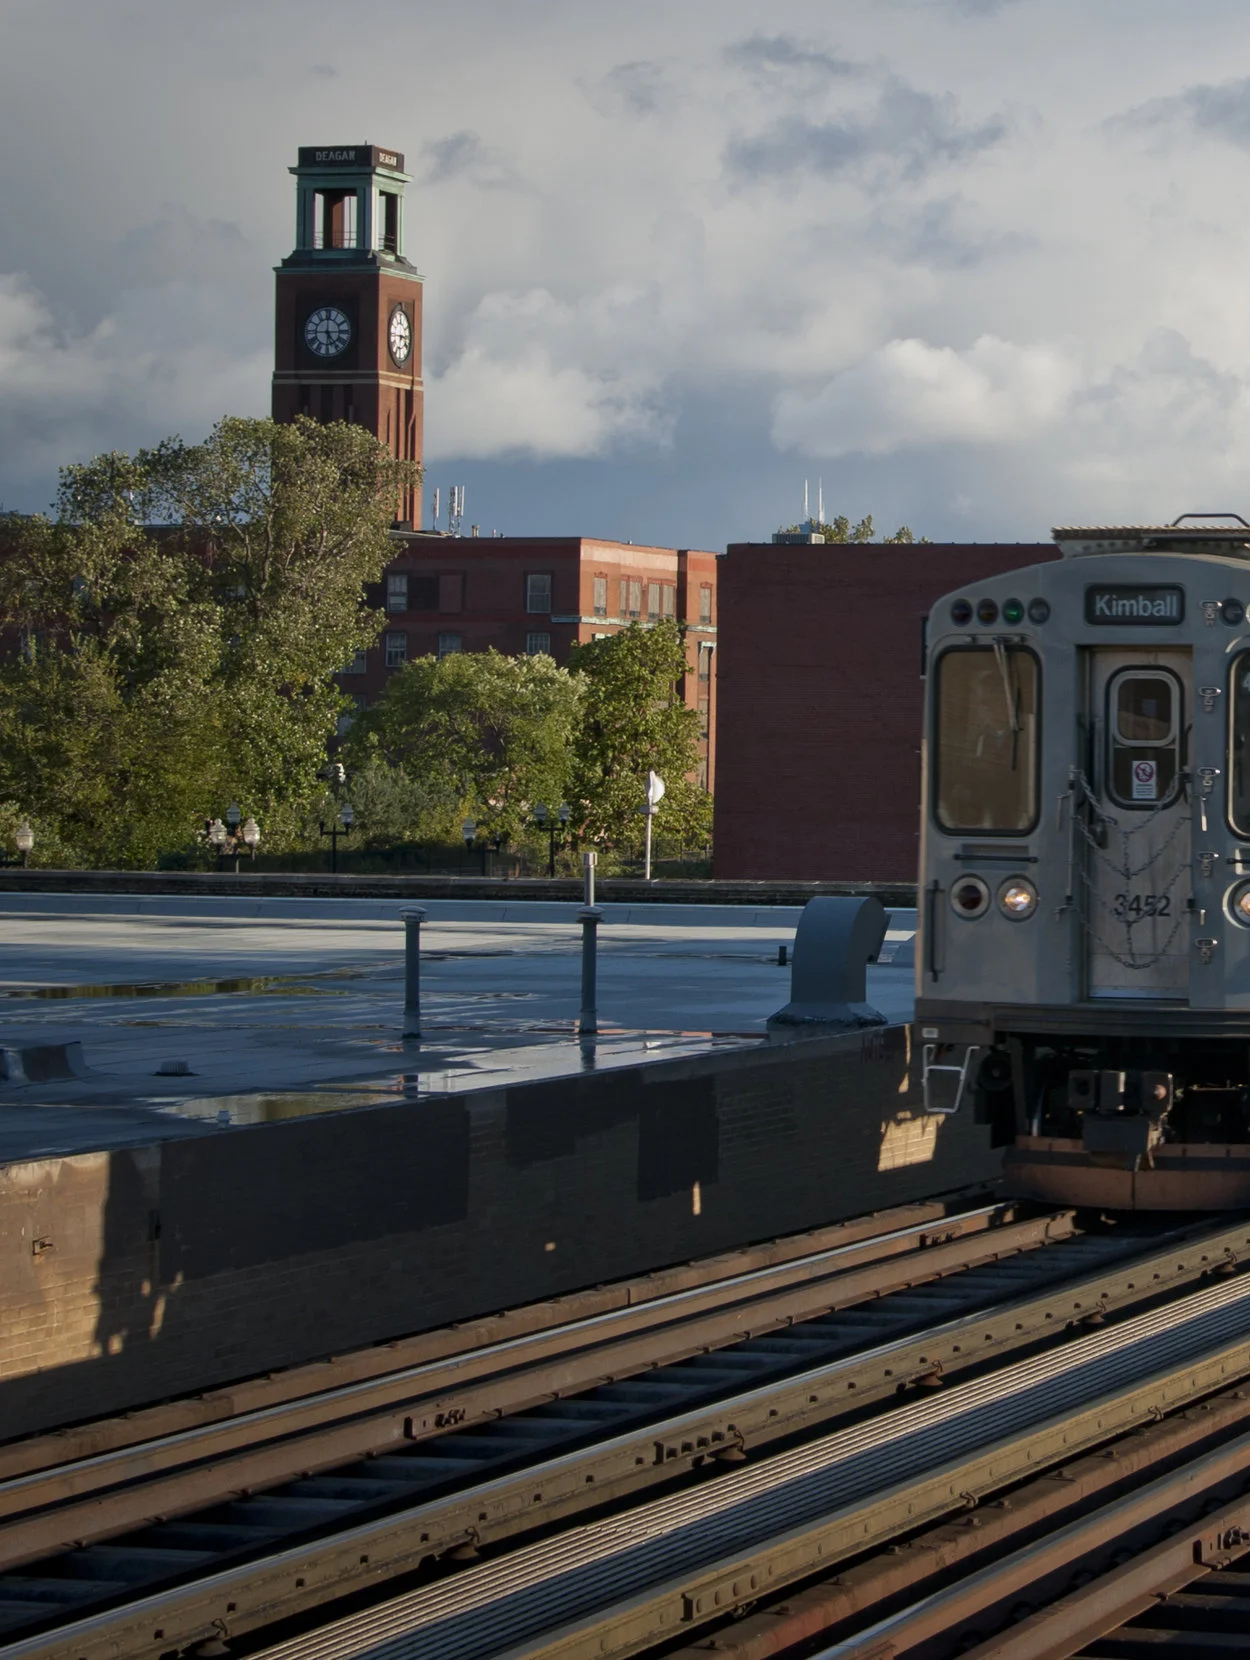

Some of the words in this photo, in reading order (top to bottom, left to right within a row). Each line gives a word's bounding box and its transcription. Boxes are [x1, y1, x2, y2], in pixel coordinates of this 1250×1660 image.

[315, 150, 356, 161] DEAGAN
[1095, 595, 1177, 617] Kimball
[1114, 893, 1171, 917] 3452
